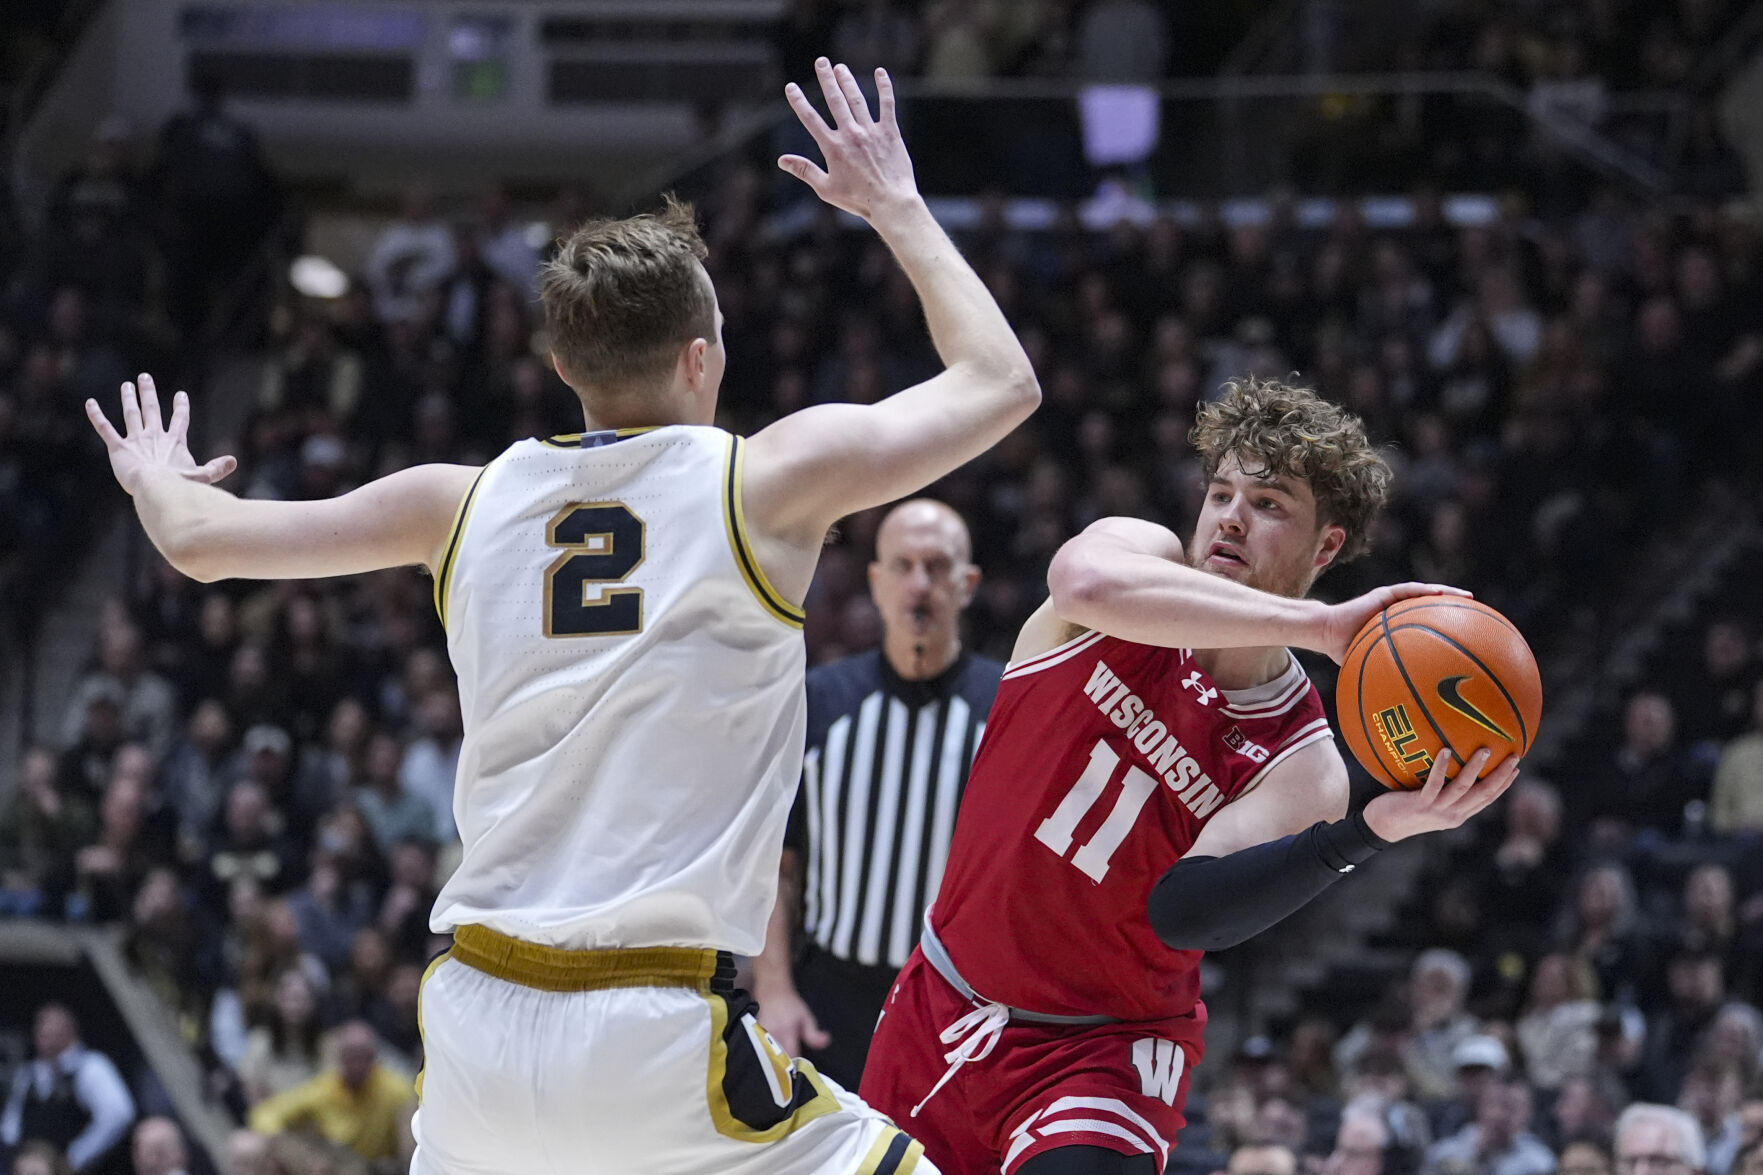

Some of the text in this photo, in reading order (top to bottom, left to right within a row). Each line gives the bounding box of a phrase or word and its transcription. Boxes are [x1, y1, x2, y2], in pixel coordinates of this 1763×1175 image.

[542, 500, 646, 639] 2
[1083, 660, 1226, 819] WISCONSIN
[1379, 703, 1435, 784] ELIT
[1034, 738, 1159, 884] 11
[1131, 1037, 1185, 1107] W
